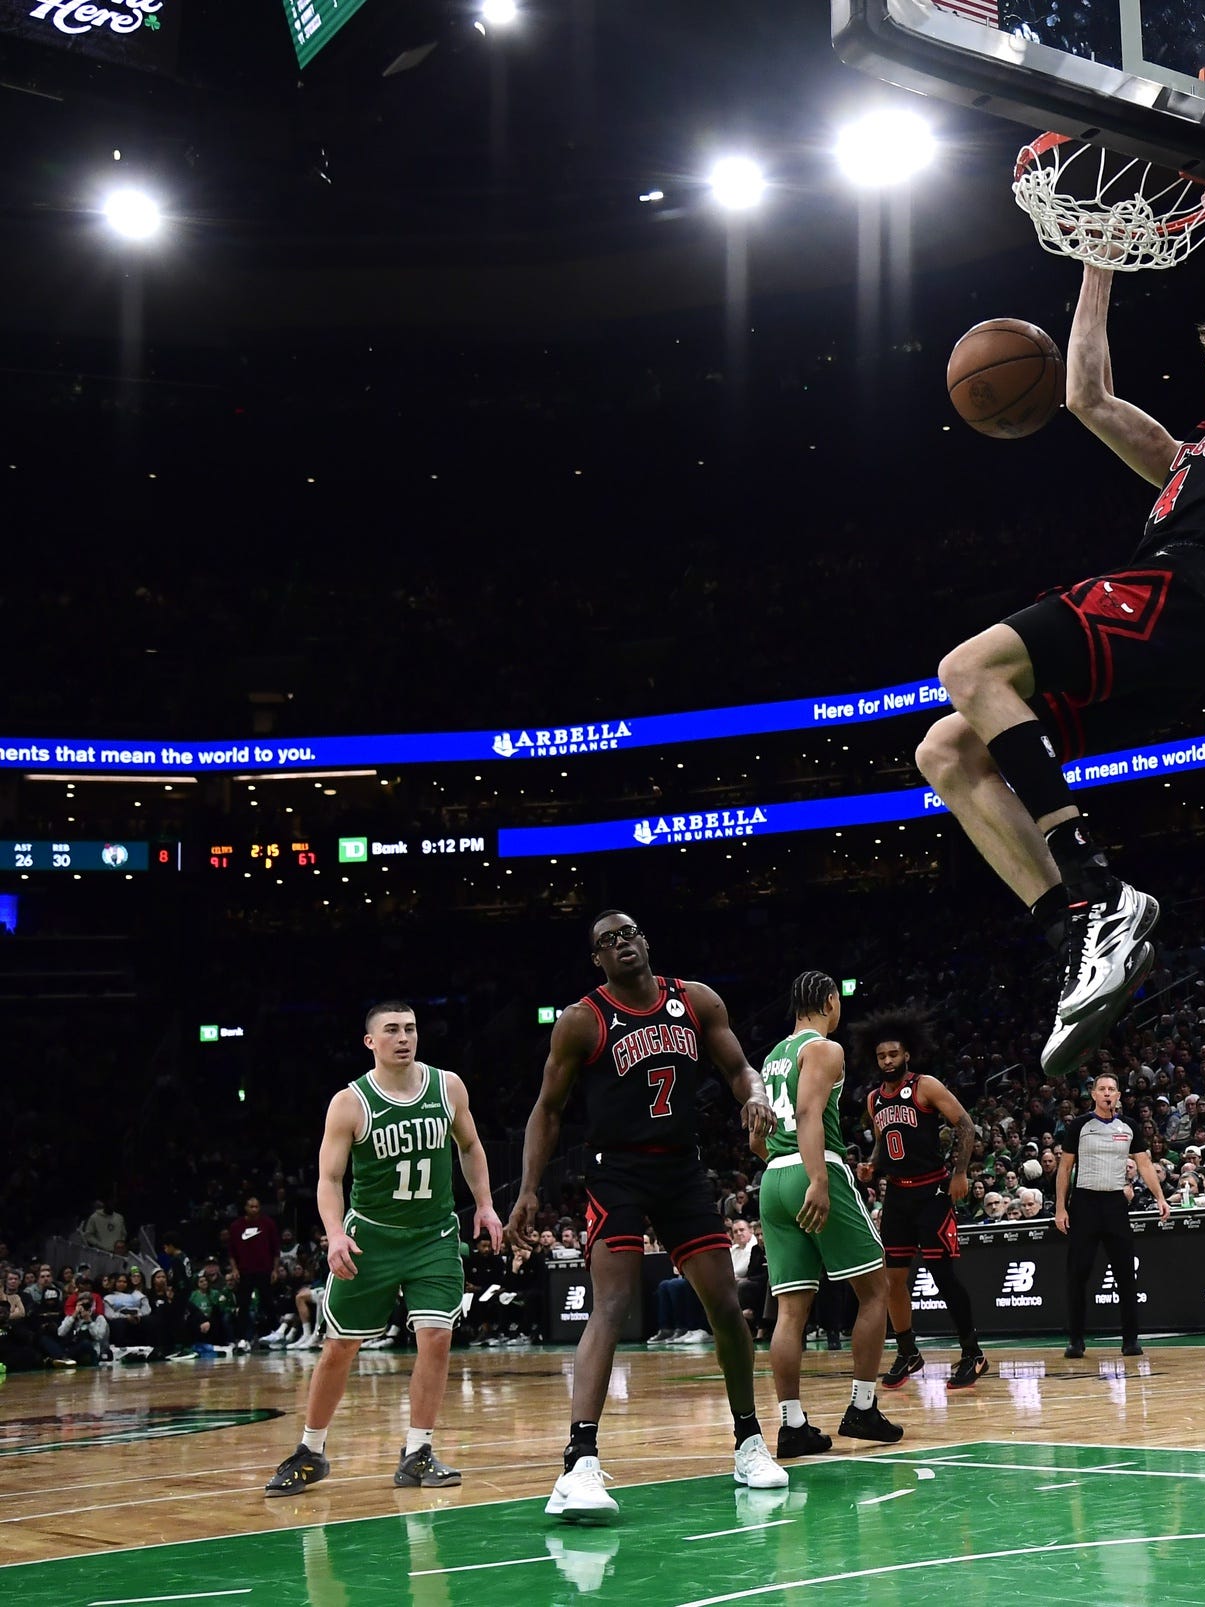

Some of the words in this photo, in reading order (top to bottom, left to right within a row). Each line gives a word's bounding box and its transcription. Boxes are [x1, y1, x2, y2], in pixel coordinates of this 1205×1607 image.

[29, 0, 142, 34] Here
[1148, 464, 1191, 526] 4
[813, 703, 854, 721] Here
[858, 698, 881, 715] for
[883, 693, 916, 711] New
[919, 686, 950, 703] Eng
[515, 721, 632, 747] ARBELLA
[55, 746, 96, 763] that
[101, 748, 156, 764] mean
[161, 748, 193, 765] the
[198, 746, 249, 765] world
[254, 747, 273, 762] to
[277, 747, 316, 765] you.
[530, 739, 618, 757] INSURANCE
[924, 792, 945, 810] Fo
[1063, 766, 1081, 785] at
[1085, 761, 1129, 779] mean
[1132, 755, 1158, 775] the
[653, 807, 767, 834] ARBELLA
[667, 825, 754, 843] INSURANCE
[14, 844, 32, 852] AST
[159, 850, 168, 863] 8
[251, 844, 280, 858] 2:15
[341, 841, 365, 858] TD
[372, 841, 408, 855] Bank
[422, 839, 456, 854] 9:12
[459, 837, 485, 852] PM
[15, 854, 34, 867] 26
[53, 854, 71, 867] 30
[210, 857, 228, 868] 91
[299, 853, 316, 865] 67
[612, 1024, 698, 1076] CHICAGO
[647, 1065, 676, 1118] 7
[372, 1117, 448, 1159] BOSTON
[886, 1130, 905, 1160] 0
[392, 1158, 432, 1200] 11
[911, 1301, 920, 1310] ew
[996, 1298, 1011, 1307] new
[1011, 1295, 1042, 1306] balance
[1095, 1293, 1112, 1304] new
